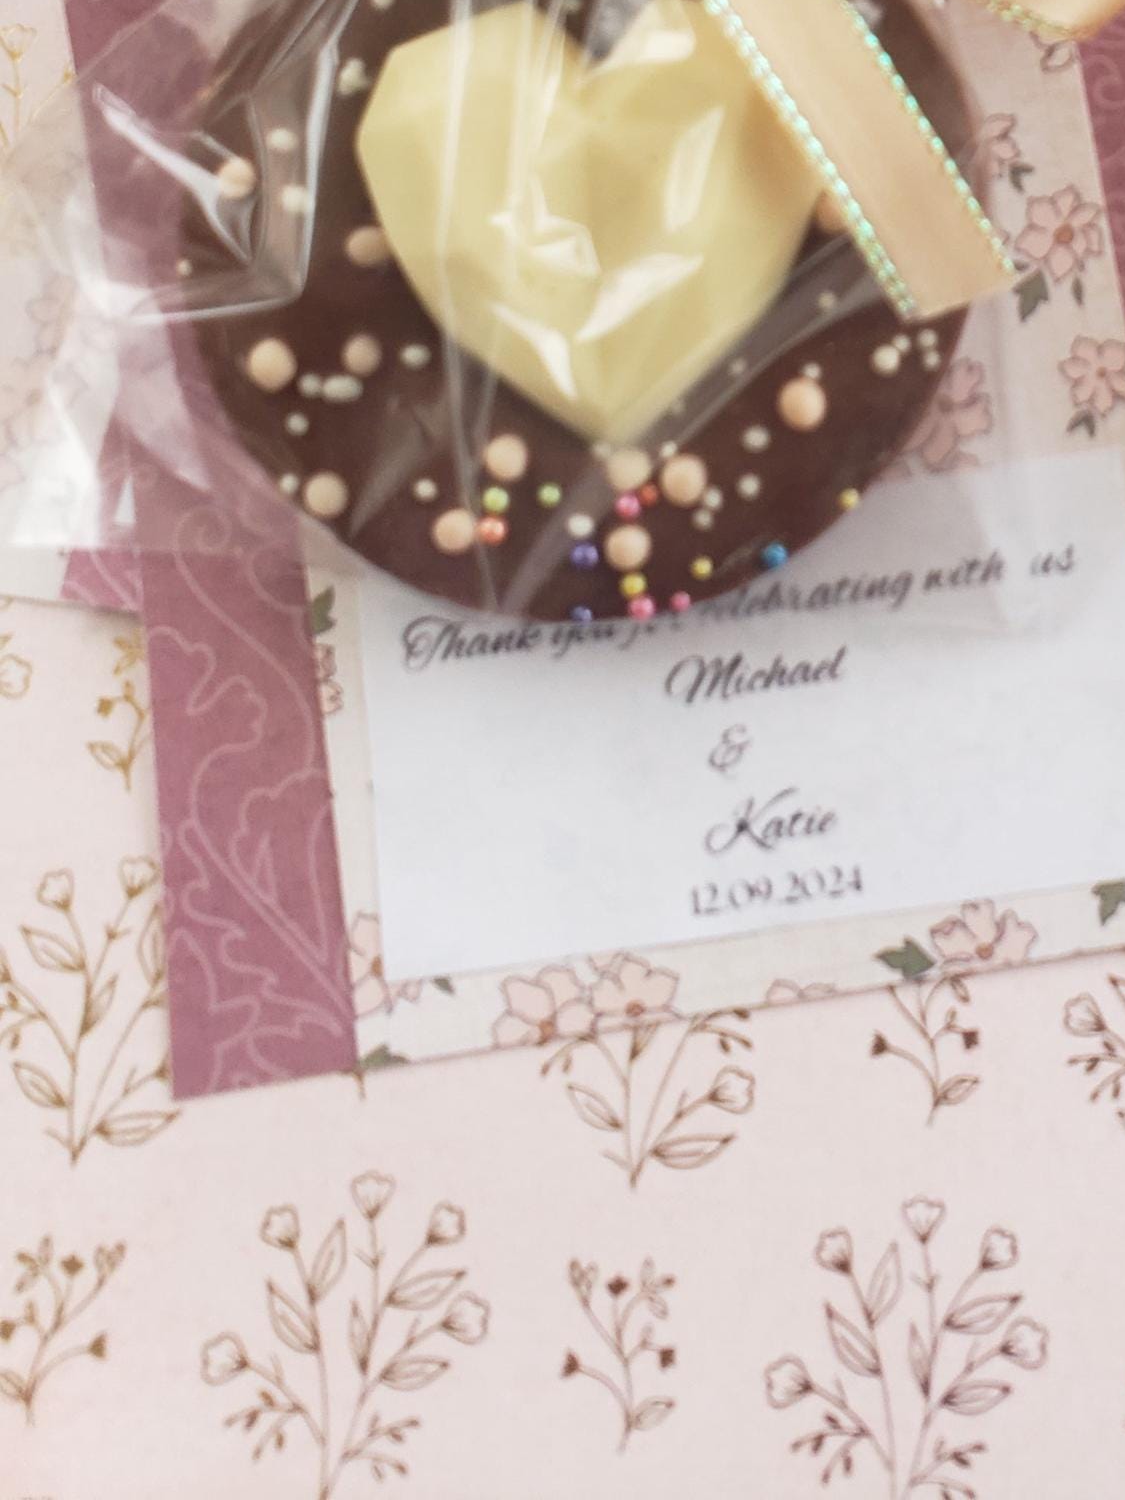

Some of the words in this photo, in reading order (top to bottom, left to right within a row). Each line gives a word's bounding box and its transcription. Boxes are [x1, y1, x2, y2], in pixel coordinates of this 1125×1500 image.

[402, 614, 542, 672] Thank
[922, 550, 1006, 590] with
[1030, 544, 1075, 576] us
[664, 645, 849, 704] Michael
[707, 724, 753, 778] &
[704, 786, 838, 854] Katie
[692, 864, 864, 915] 12.09.2024
